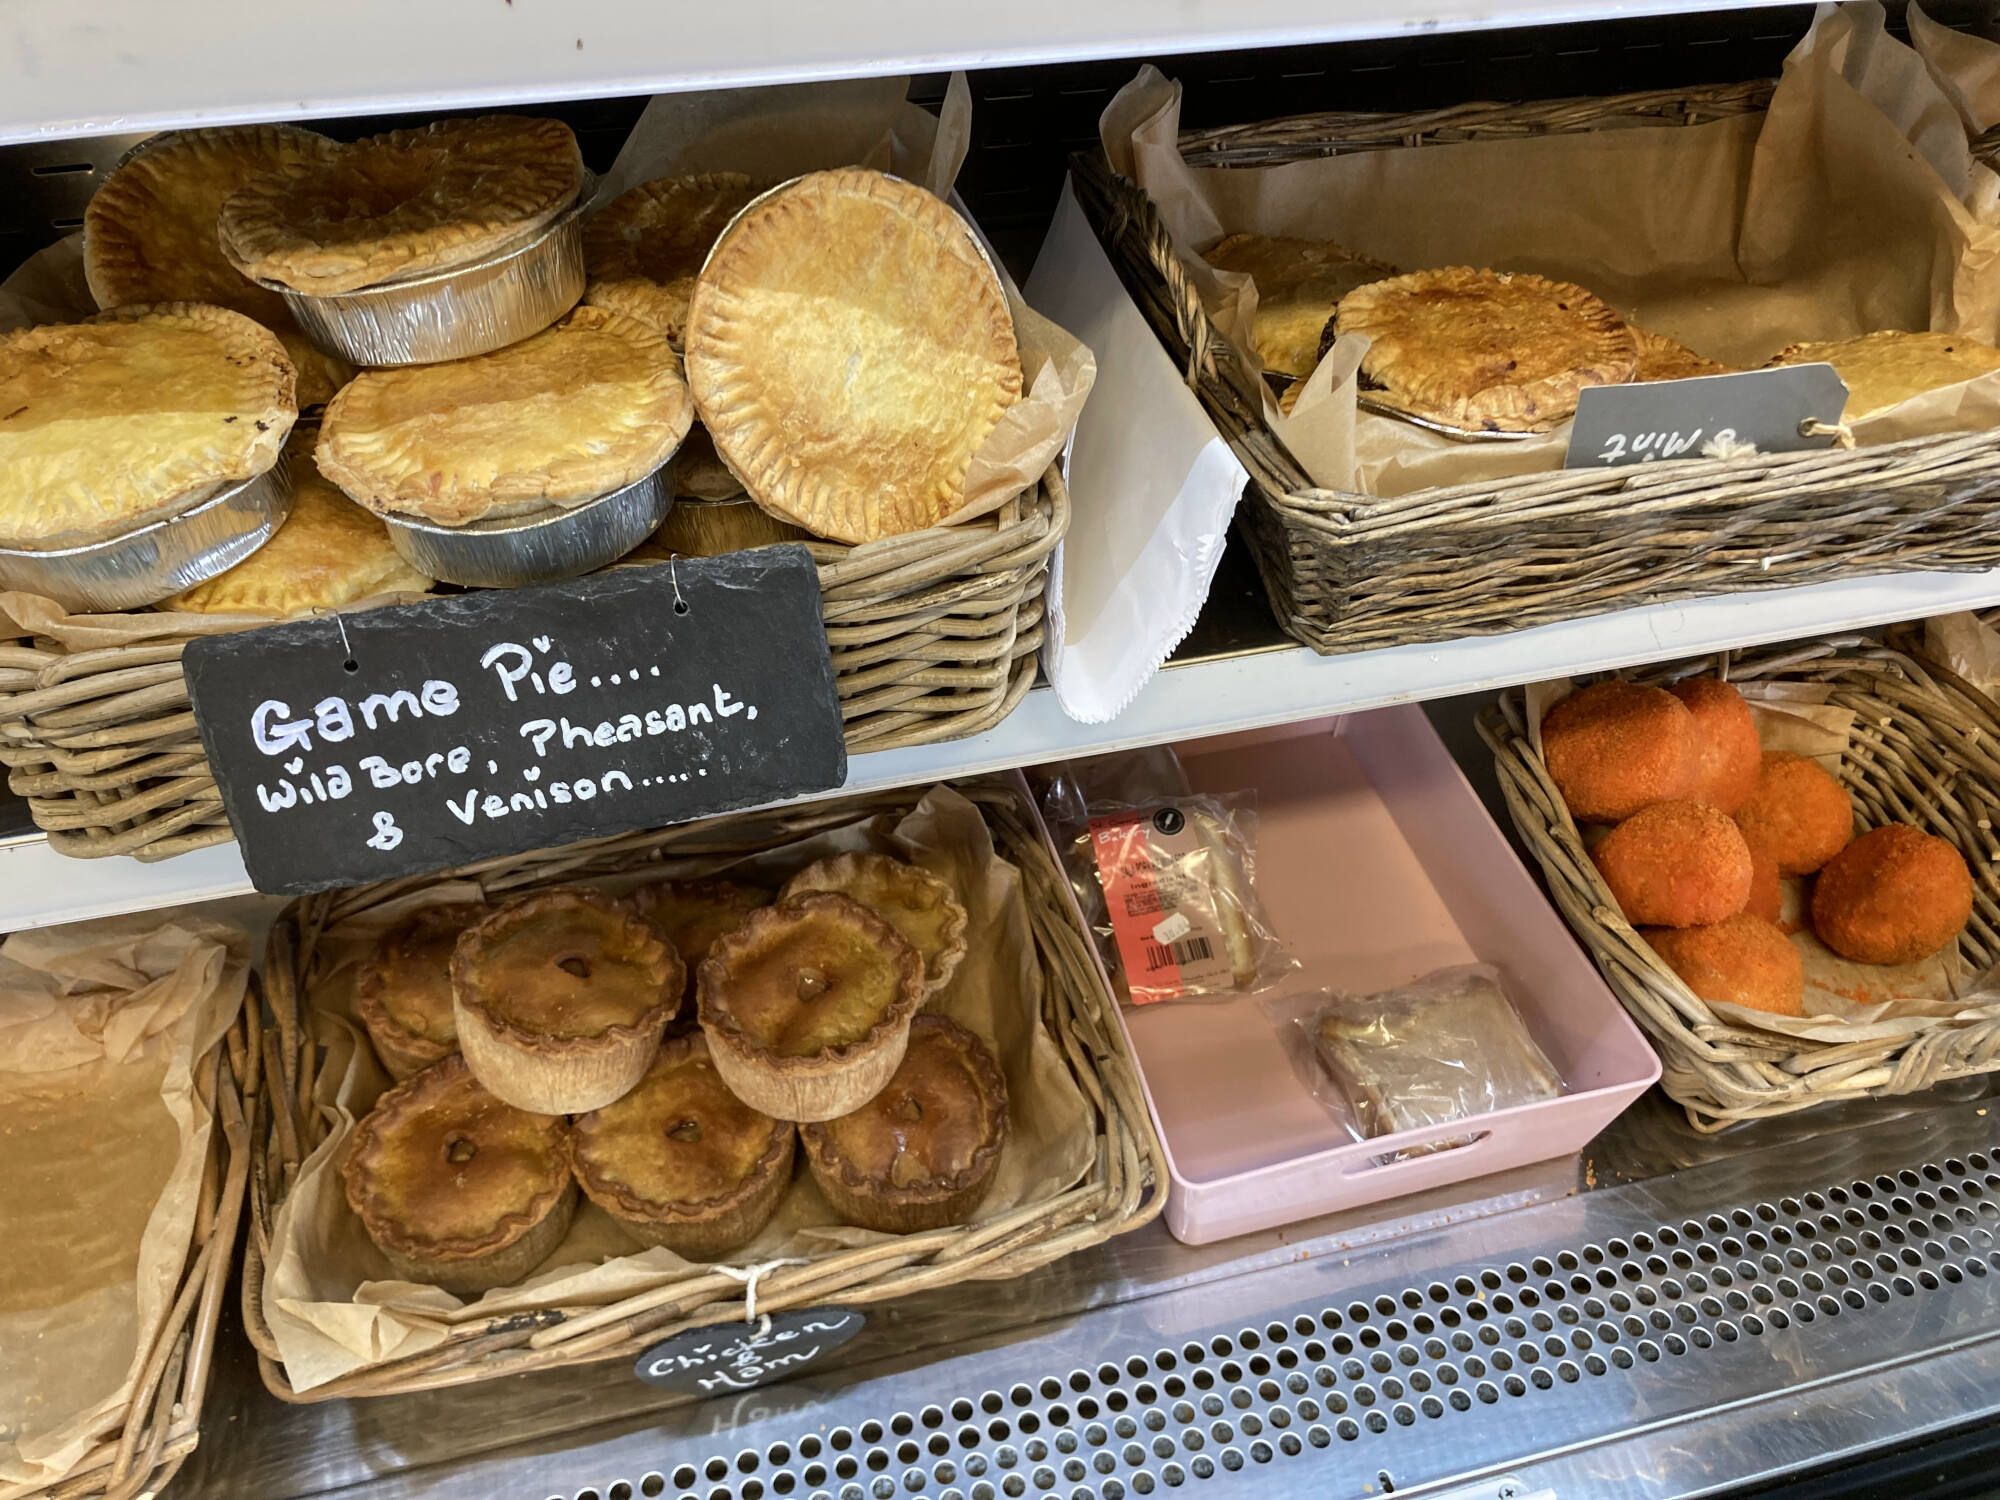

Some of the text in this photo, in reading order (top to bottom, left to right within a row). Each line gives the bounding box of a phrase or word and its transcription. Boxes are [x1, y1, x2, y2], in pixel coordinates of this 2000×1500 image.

[1597, 428, 1702, 462] Mint
[251, 679, 460, 755] Game
[519, 683, 758, 757] Pheasant,
[366, 810, 404, 851] &
[648, 1315, 851, 1377] Chicken
